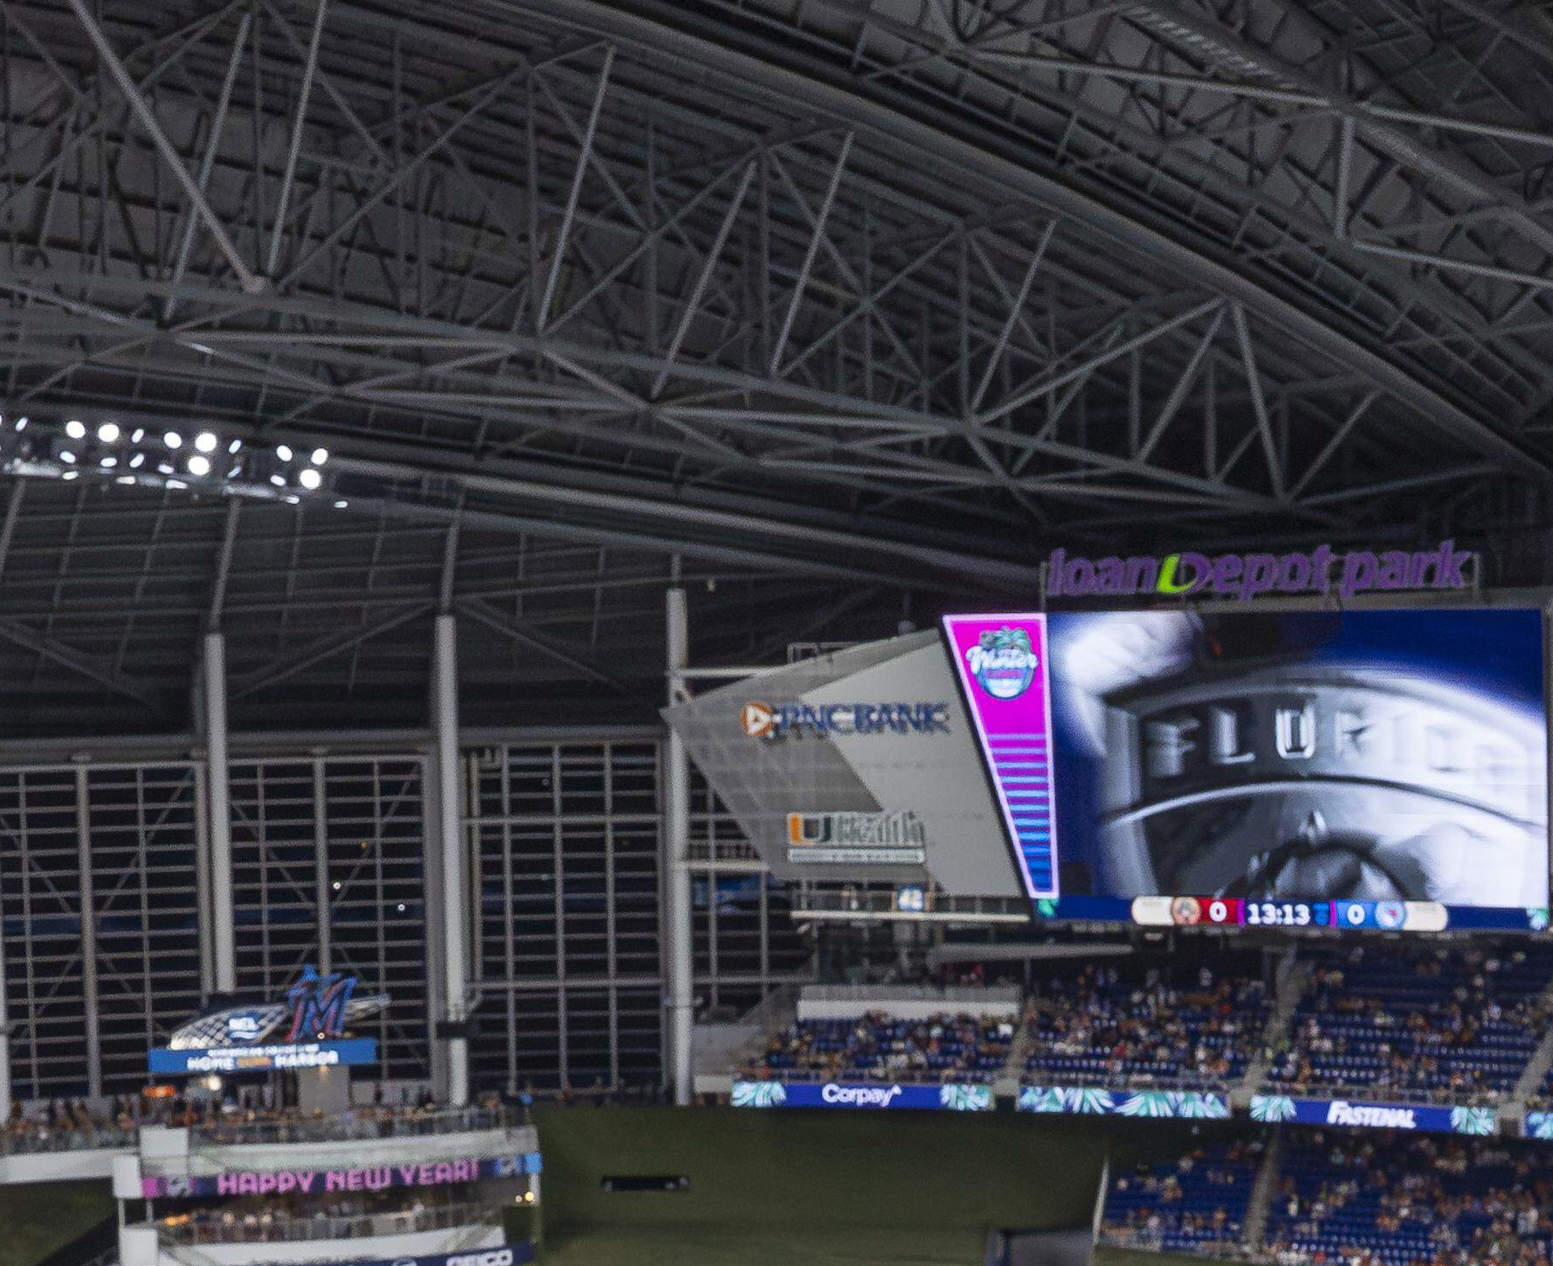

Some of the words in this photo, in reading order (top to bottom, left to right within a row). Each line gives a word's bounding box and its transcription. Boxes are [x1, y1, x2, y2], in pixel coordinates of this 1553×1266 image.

[1341, 539, 1473, 600] park
[1208, 901, 1228, 922] 0
[1247, 902, 1312, 926] 13:13
[1347, 904, 1366, 926] 0
[821, 1083, 902, 1107] Corpay
[216, 1170, 315, 1197] HAPPY
[325, 1166, 394, 1193] NEW
[398, 1158, 480, 1187] YEAR!
